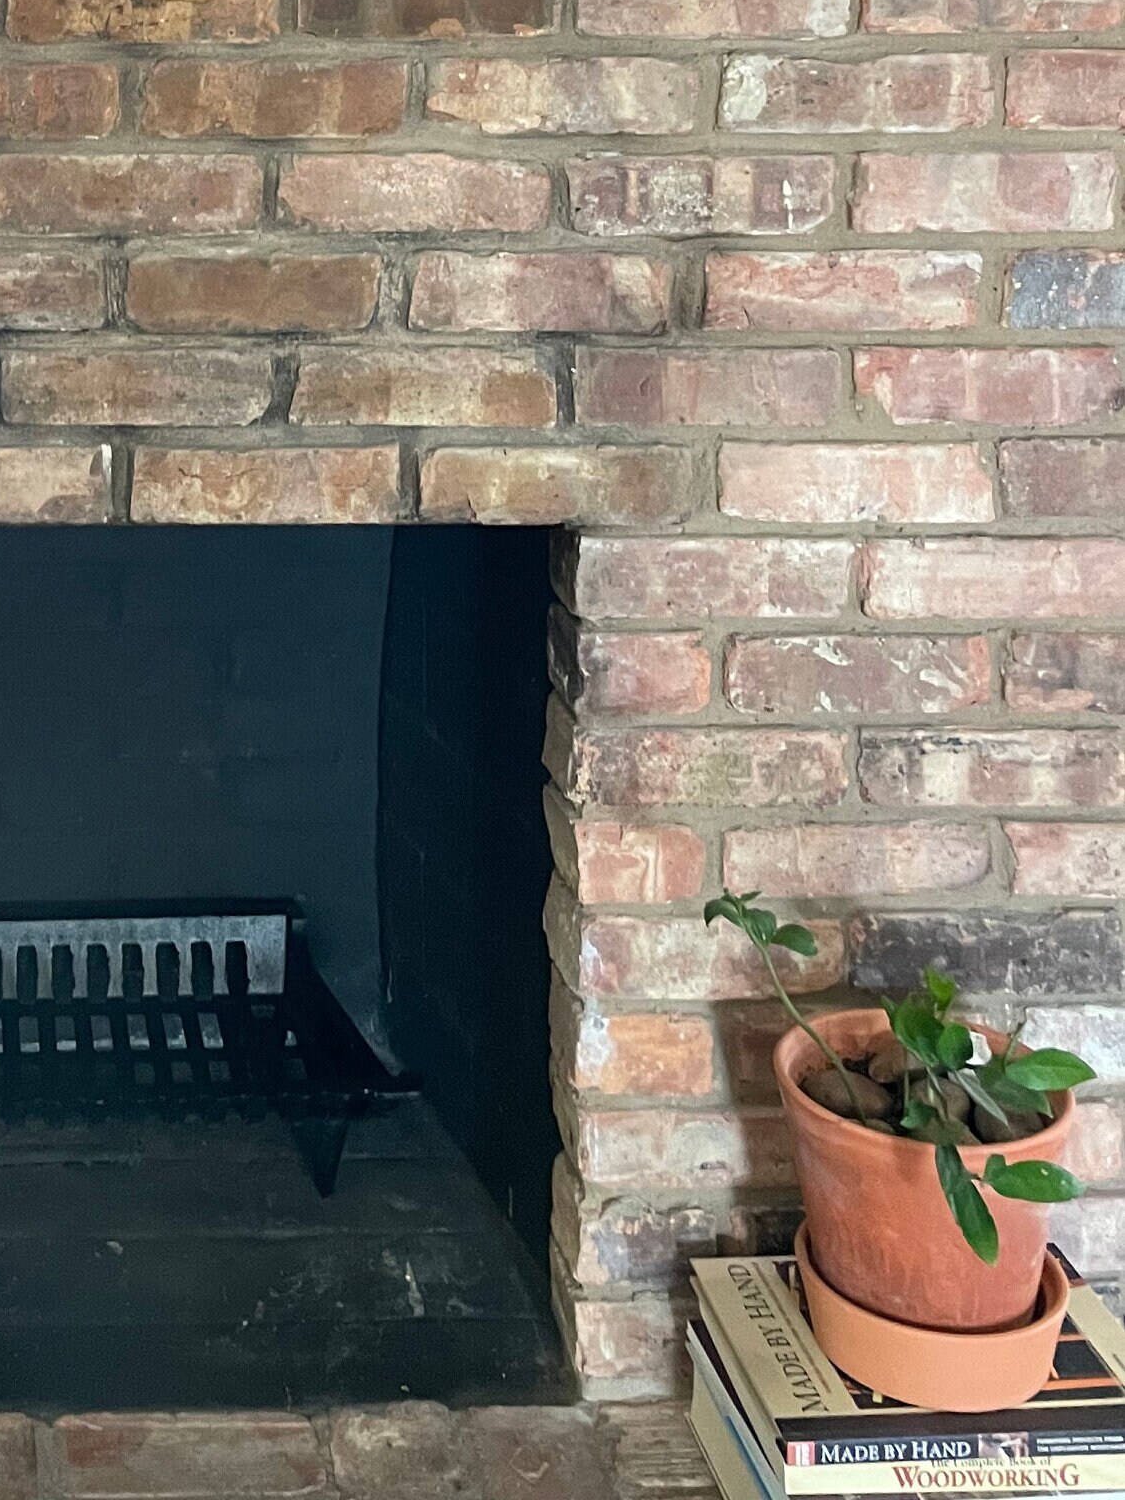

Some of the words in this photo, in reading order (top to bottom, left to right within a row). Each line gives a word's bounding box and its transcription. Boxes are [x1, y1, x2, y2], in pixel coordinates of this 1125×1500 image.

[727, 1263, 775, 1320] HAND
[758, 1324, 792, 1347] BY
[775, 1352, 829, 1413] MADE
[821, 1444, 880, 1463] MADE
[884, 1444, 907, 1460] BY
[911, 1441, 971, 1459] HAND
[891, 1463, 1080, 1488] WOODWORKING
